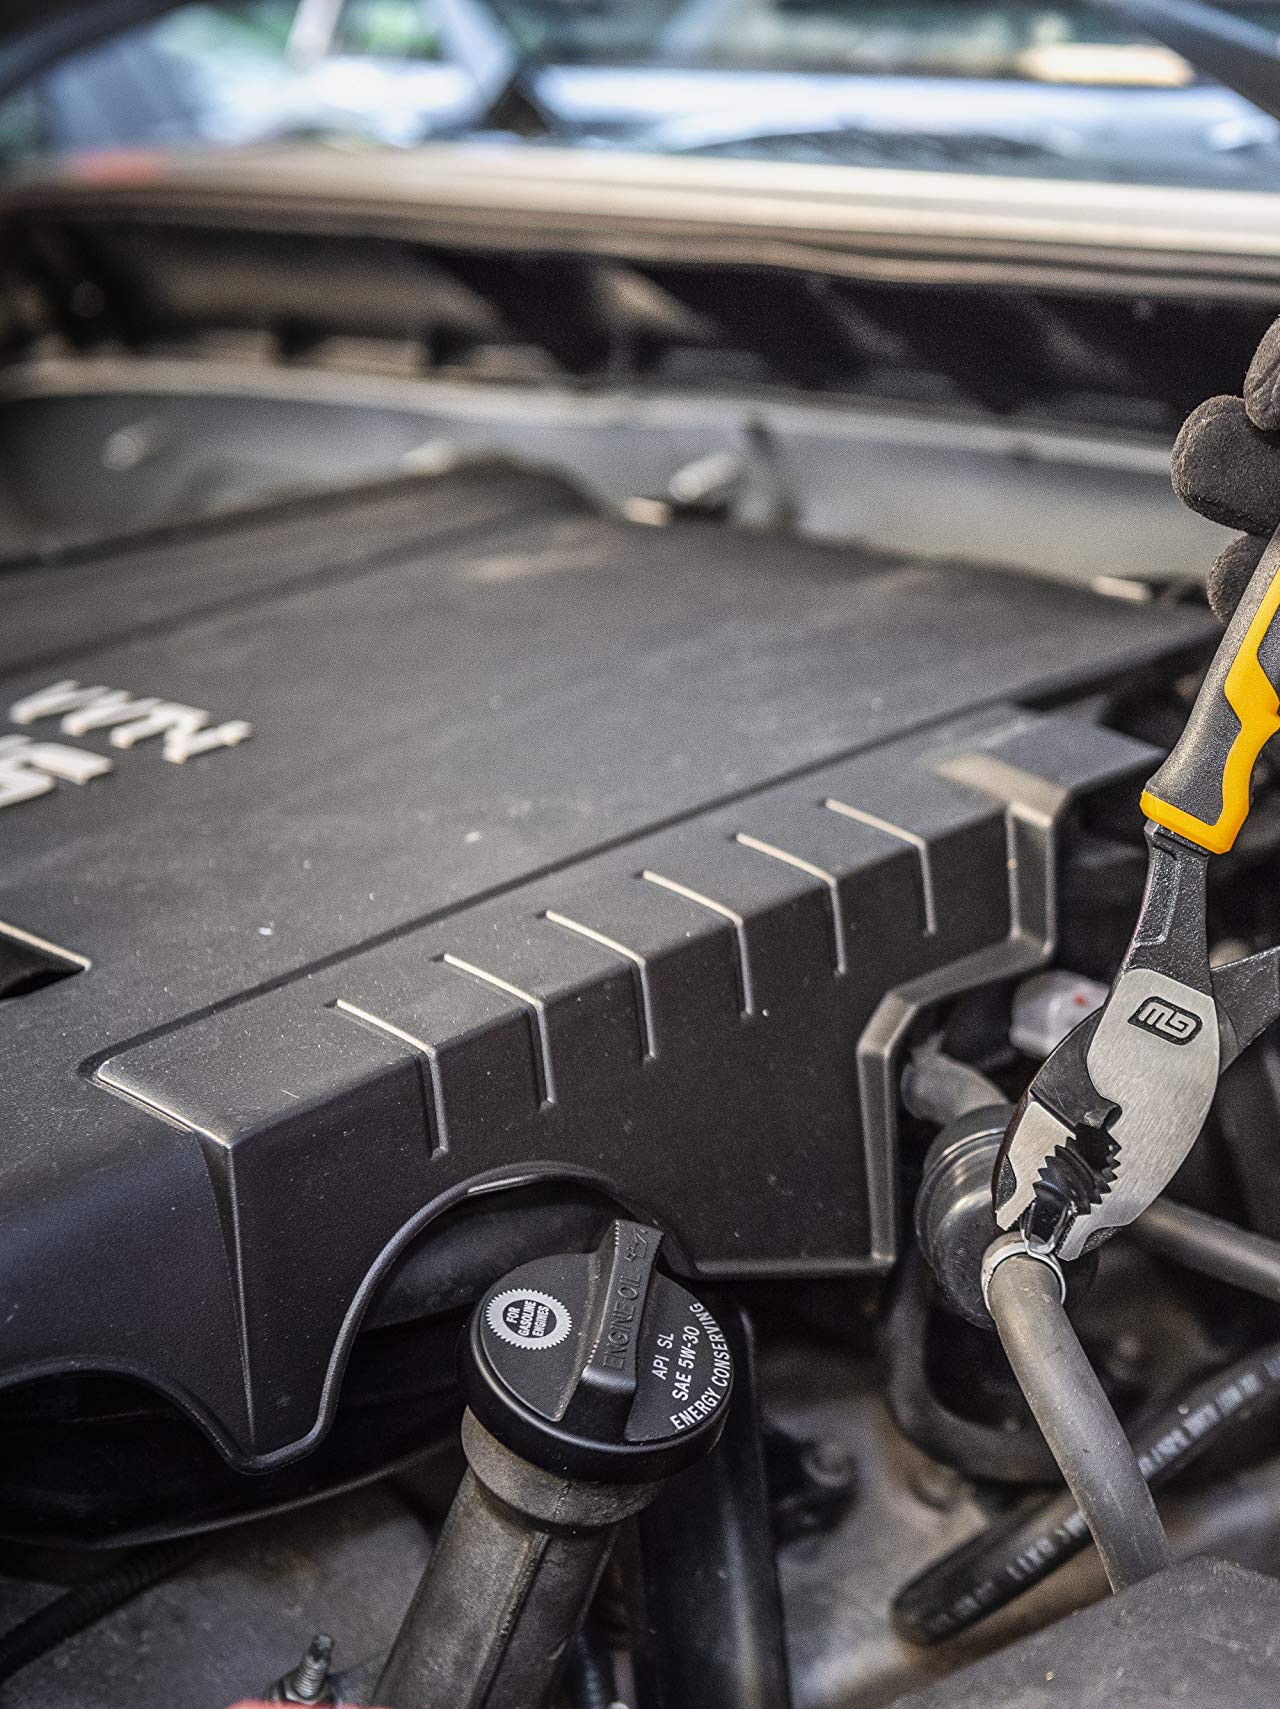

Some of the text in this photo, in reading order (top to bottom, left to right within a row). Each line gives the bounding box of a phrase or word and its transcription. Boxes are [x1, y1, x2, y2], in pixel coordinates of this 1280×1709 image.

[506, 1306, 520, 1324] FOR
[518, 1300, 537, 1336] GASOLINE
[532, 1305, 550, 1336] ENGINES
[602, 1274, 642, 1371] ENGINE OIL
[651, 1333, 674, 1380] API SL
[669, 1302, 731, 1430] ENERGY CONSERVING
[671, 1325, 700, 1401] SAE 5W-30
